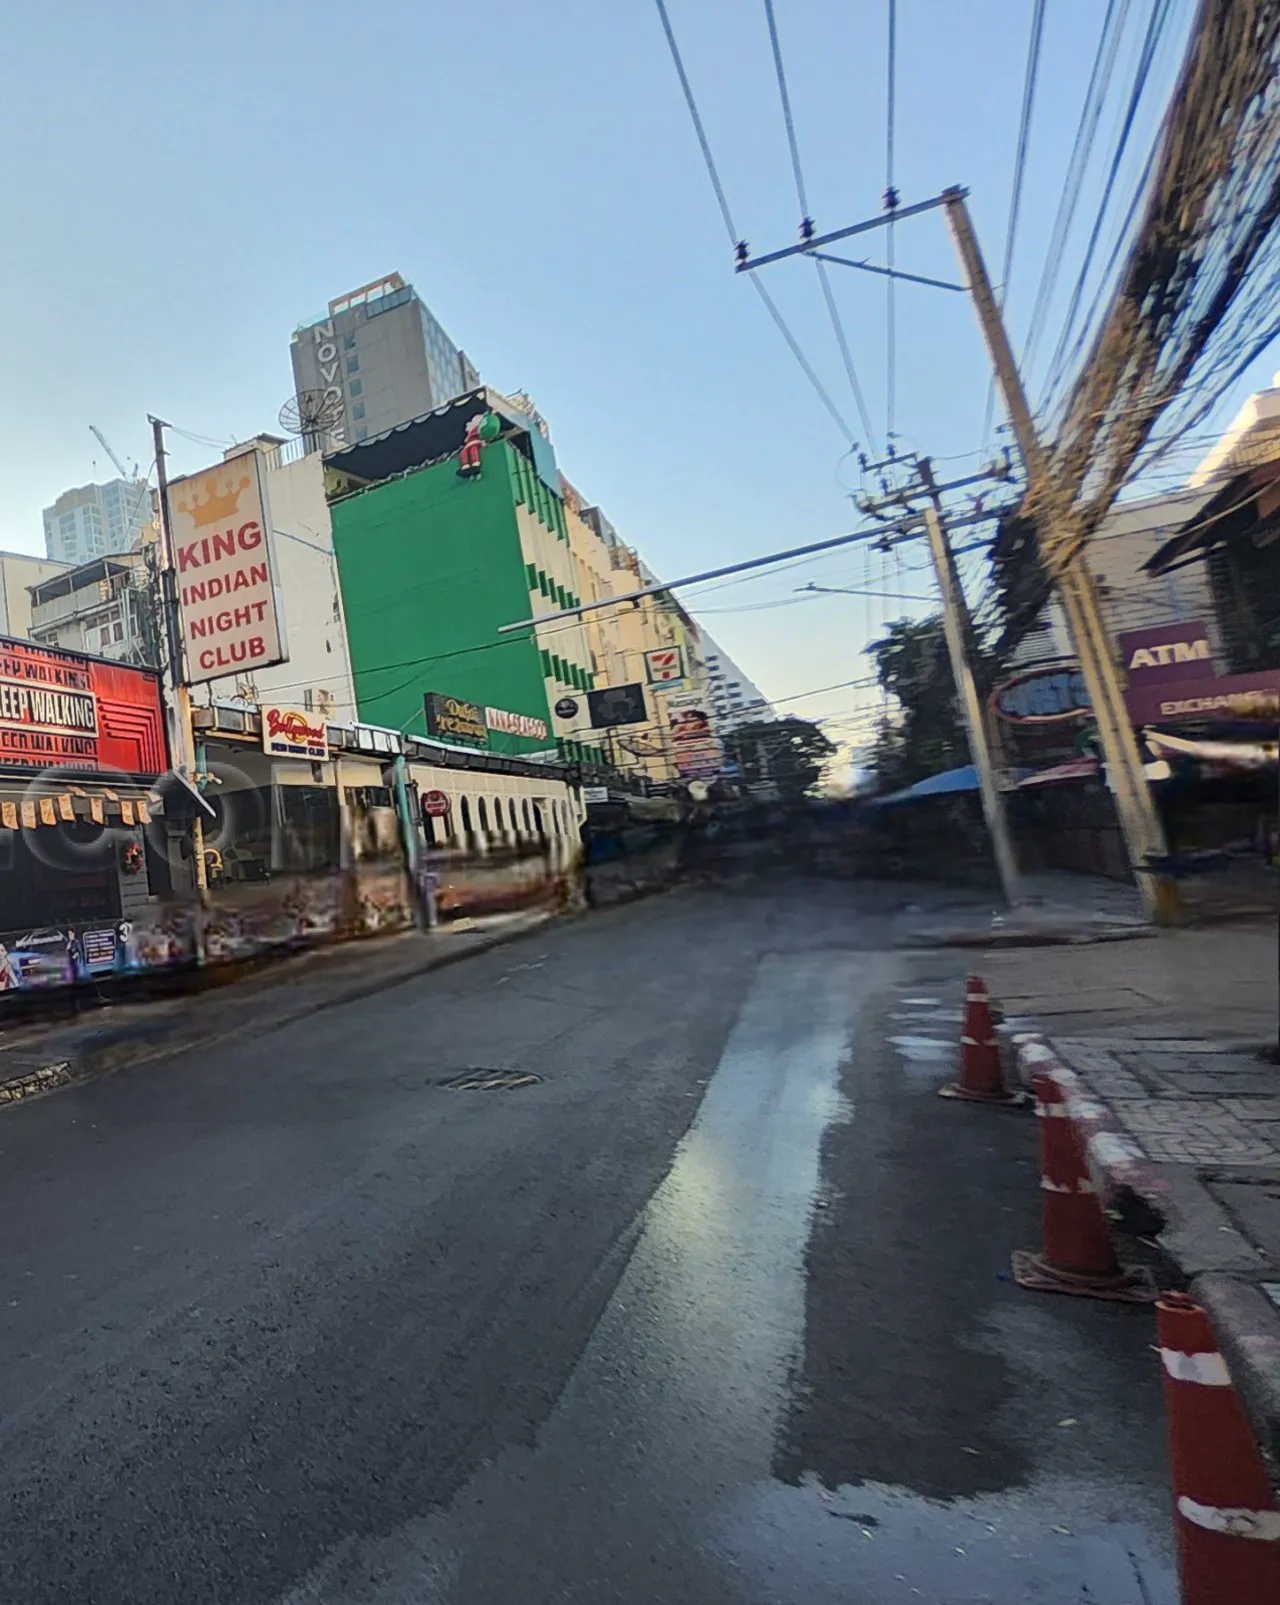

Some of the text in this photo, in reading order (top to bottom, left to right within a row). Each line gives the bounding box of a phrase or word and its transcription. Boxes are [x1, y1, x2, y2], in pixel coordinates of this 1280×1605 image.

[177, 521, 263, 574] KING
[182, 562, 269, 607] INDIAN
[190, 600, 268, 641] NIGHT
[199, 636, 266, 670] CLUB
[1129, 639, 1210, 670] ATM
[28, 689, 95, 729] WALKING
